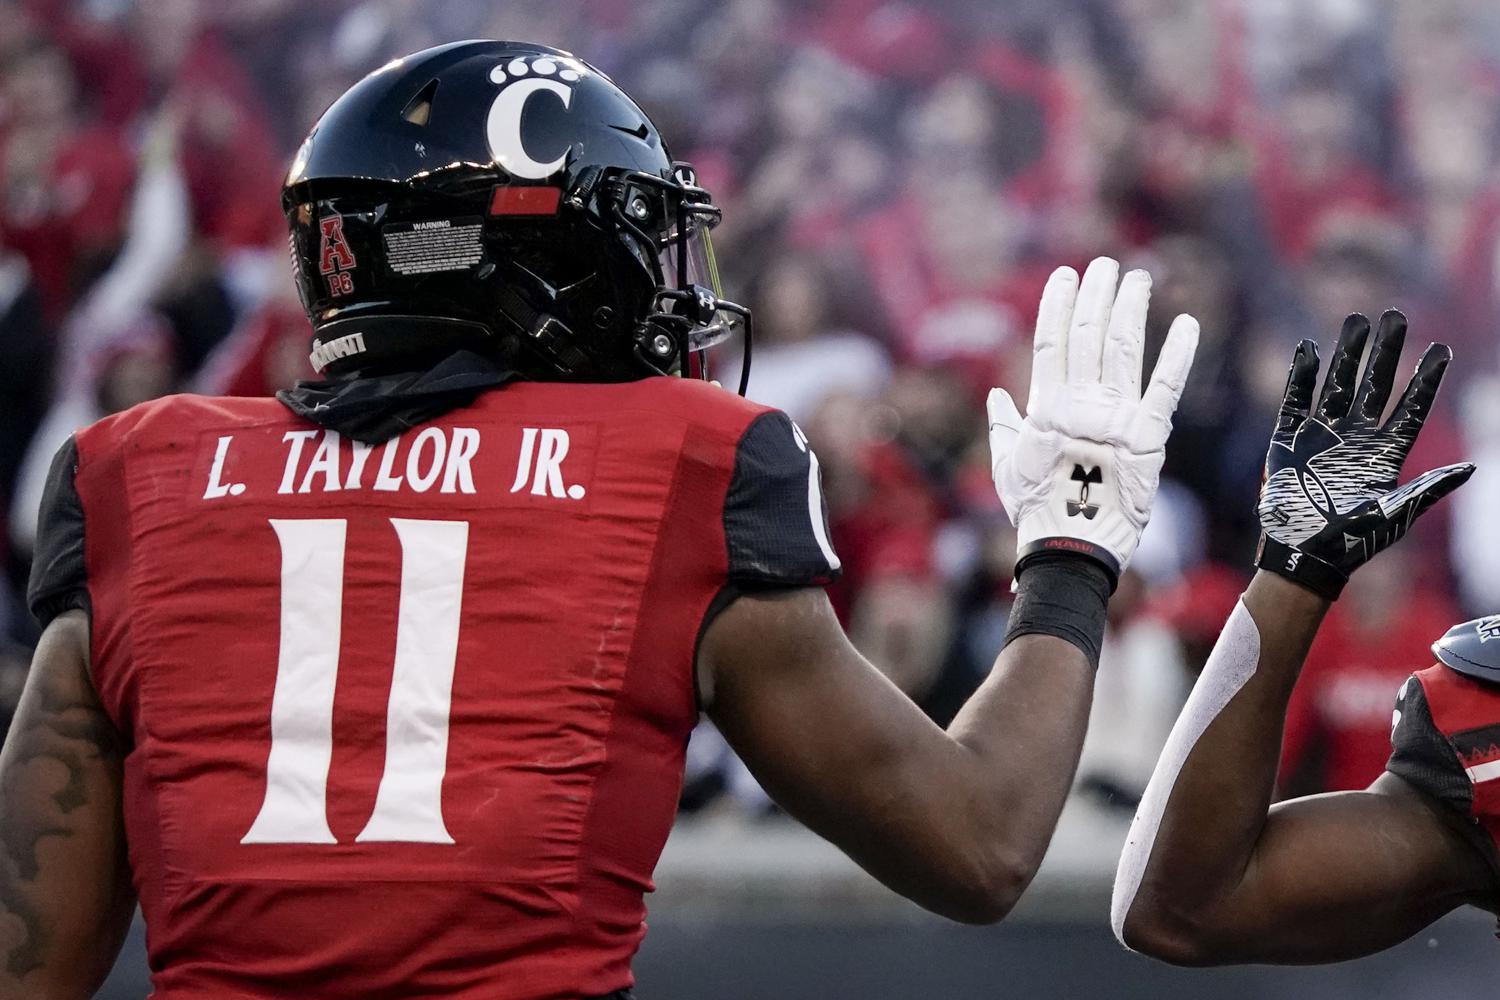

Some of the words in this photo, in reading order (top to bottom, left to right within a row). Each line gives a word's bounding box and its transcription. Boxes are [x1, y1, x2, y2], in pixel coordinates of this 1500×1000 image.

[486, 78, 572, 180] C
[412, 220, 451, 231] WARNING
[328, 274, 354, 298] P6
[202, 435, 247, 500] L.
[277, 427, 481, 498] TAYLOR
[510, 427, 586, 500] JR.
[1285, 552, 1303, 572] UA
[240, 518, 469, 844] 11
